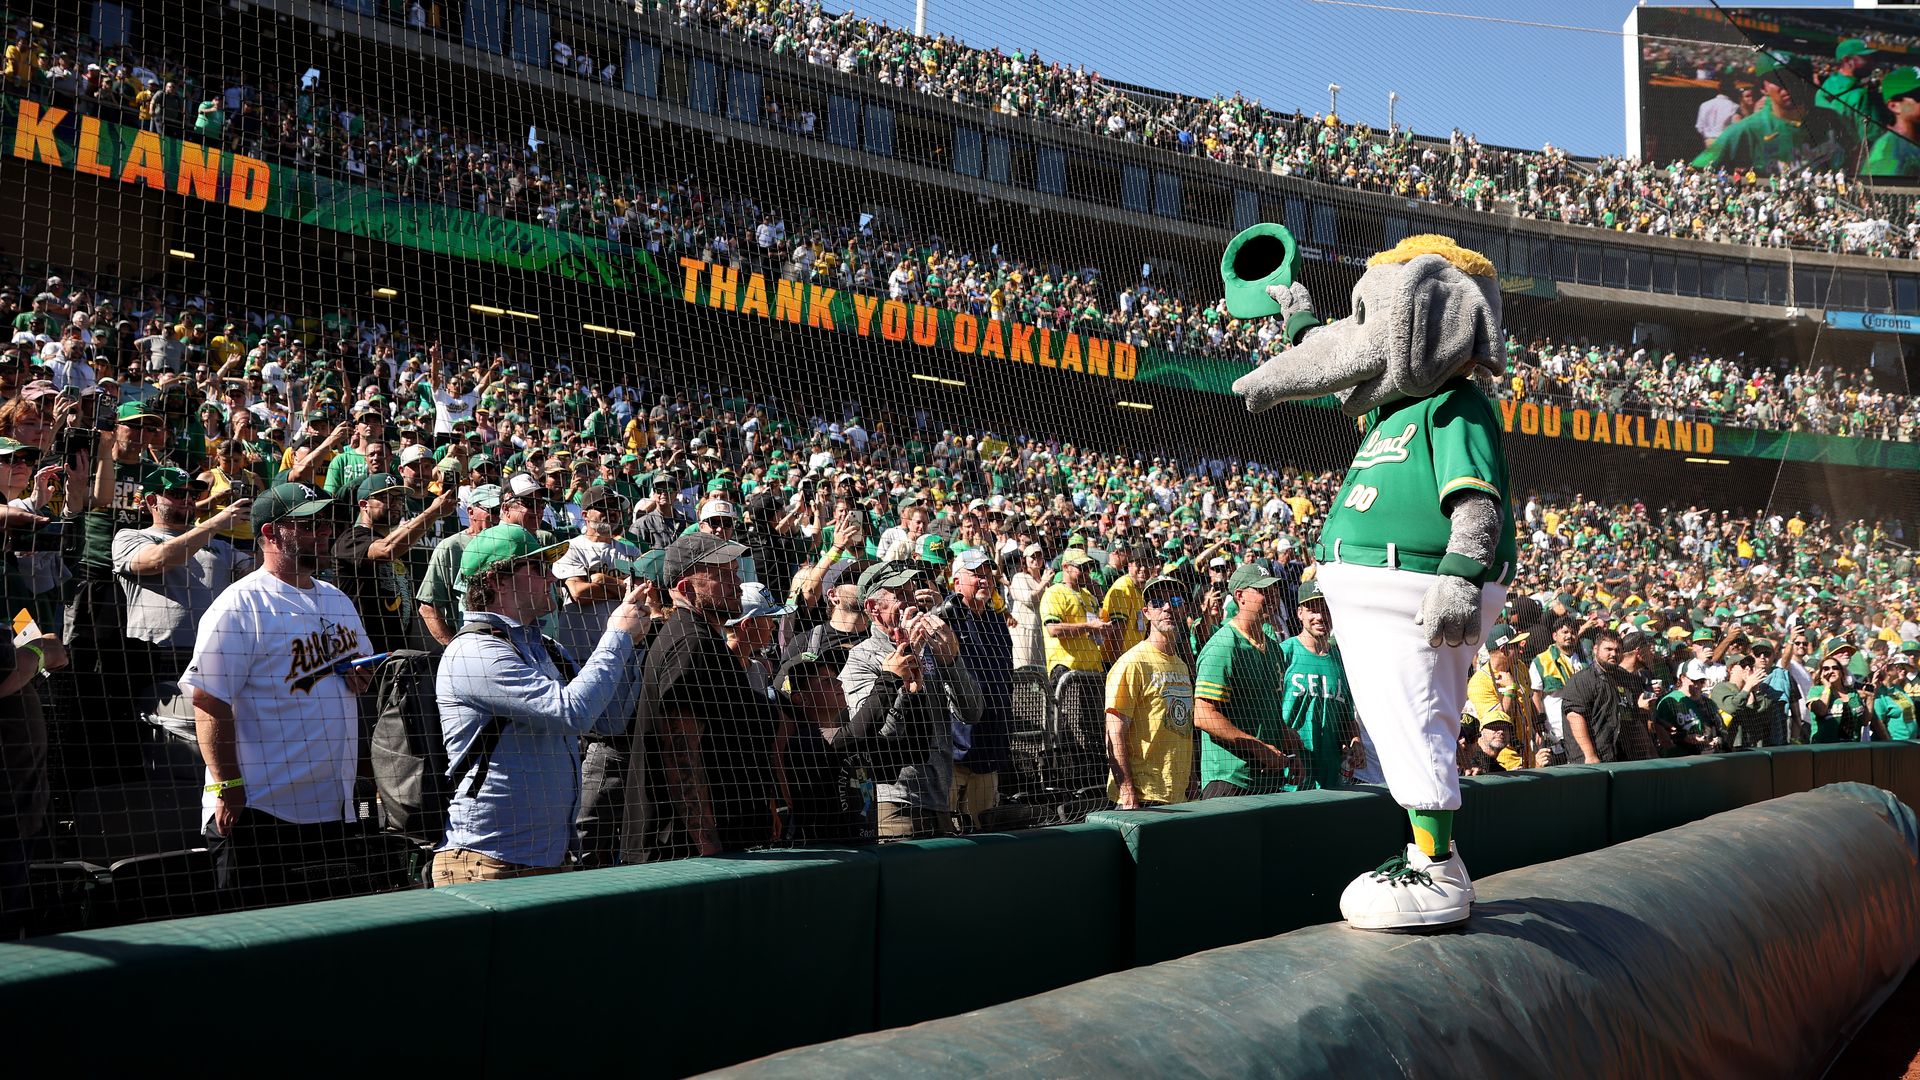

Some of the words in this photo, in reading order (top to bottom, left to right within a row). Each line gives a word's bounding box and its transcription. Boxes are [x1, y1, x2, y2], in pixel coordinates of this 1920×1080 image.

[13, 99, 270, 212] KLAND
[680, 256, 836, 330] THANK
[853, 293, 938, 347] YOU
[953, 312, 1136, 381] OAKLAND
[1862, 313, 1911, 329] Corona
[1500, 399, 1561, 437] YOU
[1572, 408, 1714, 454] OAKLAND
[1344, 484, 1379, 513] 00
[1291, 673, 1346, 703] SELL
